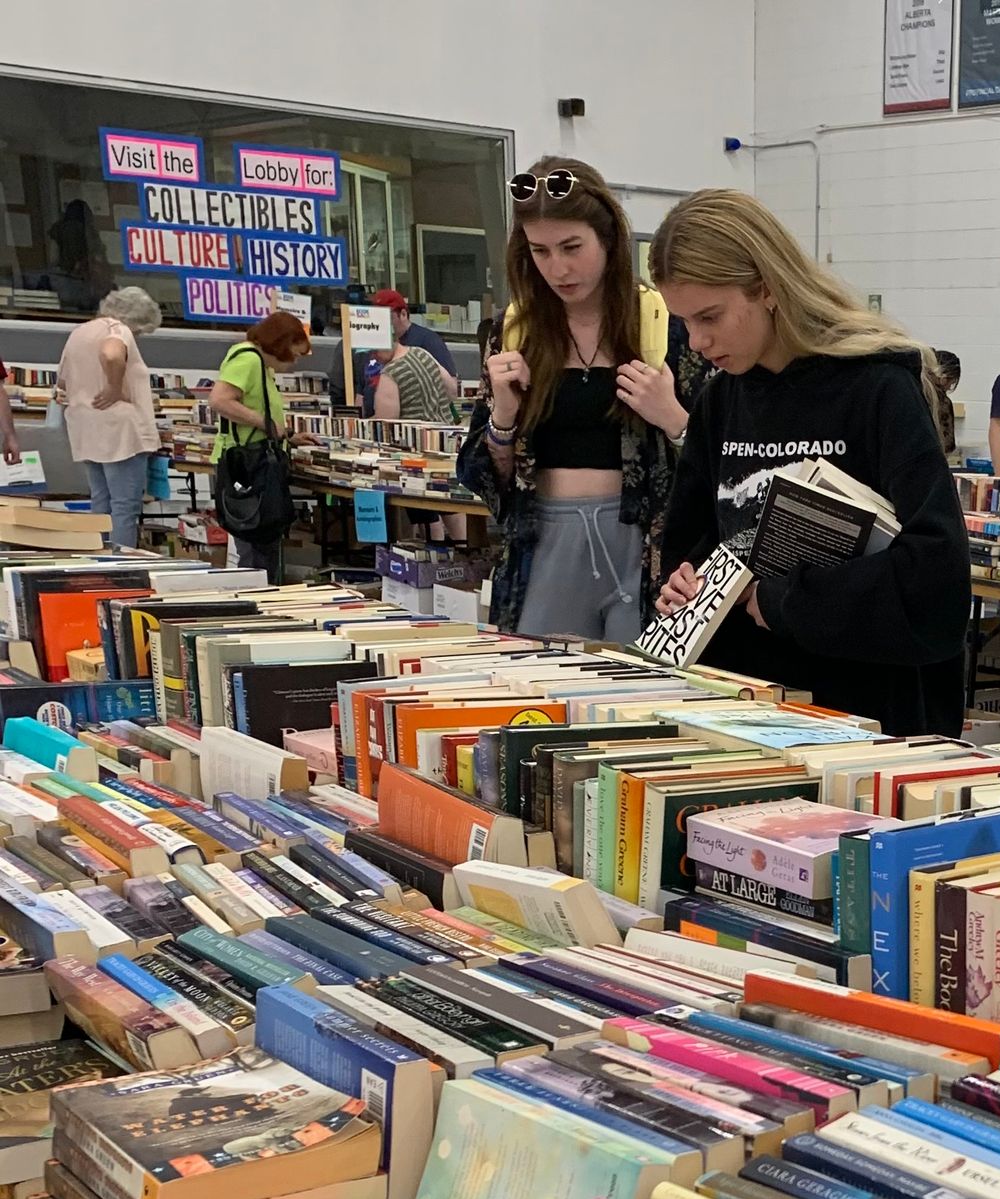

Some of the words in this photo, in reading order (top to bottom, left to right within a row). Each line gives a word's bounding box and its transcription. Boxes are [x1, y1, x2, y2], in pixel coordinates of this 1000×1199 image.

[111, 144, 157, 171] Visit
[163, 150, 194, 174] the
[243, 156, 299, 187] Lobby
[305, 163, 334, 187] for:
[144, 185, 314, 235] COLLECTIBLES
[128, 228, 229, 269] CULTURE
[249, 239, 341, 278] HISTORY
[189, 278, 277, 317] POLITICS
[620, 780, 630, 836] Graham
[618, 838, 628, 886] Greene
[873, 872, 889, 880] THE
[712, 870, 728, 890] AT
[730, 876, 776, 907] LARGE
[780, 899, 815, 918] GOODMAN
[913, 900, 924, 941] where
[215, 939, 244, 958] WOMEN
[913, 948, 920, 966] we
[940, 929, 958, 971] The
[149, 960, 179, 983] VALLEY
[185, 984, 212, 1004] MOON
[119, 1103, 229, 1131] WATER
[243, 1083, 302, 1105] FOR
[132, 1088, 310, 1138] ELEPHANTS
[756, 1162, 794, 1185] CIARA
